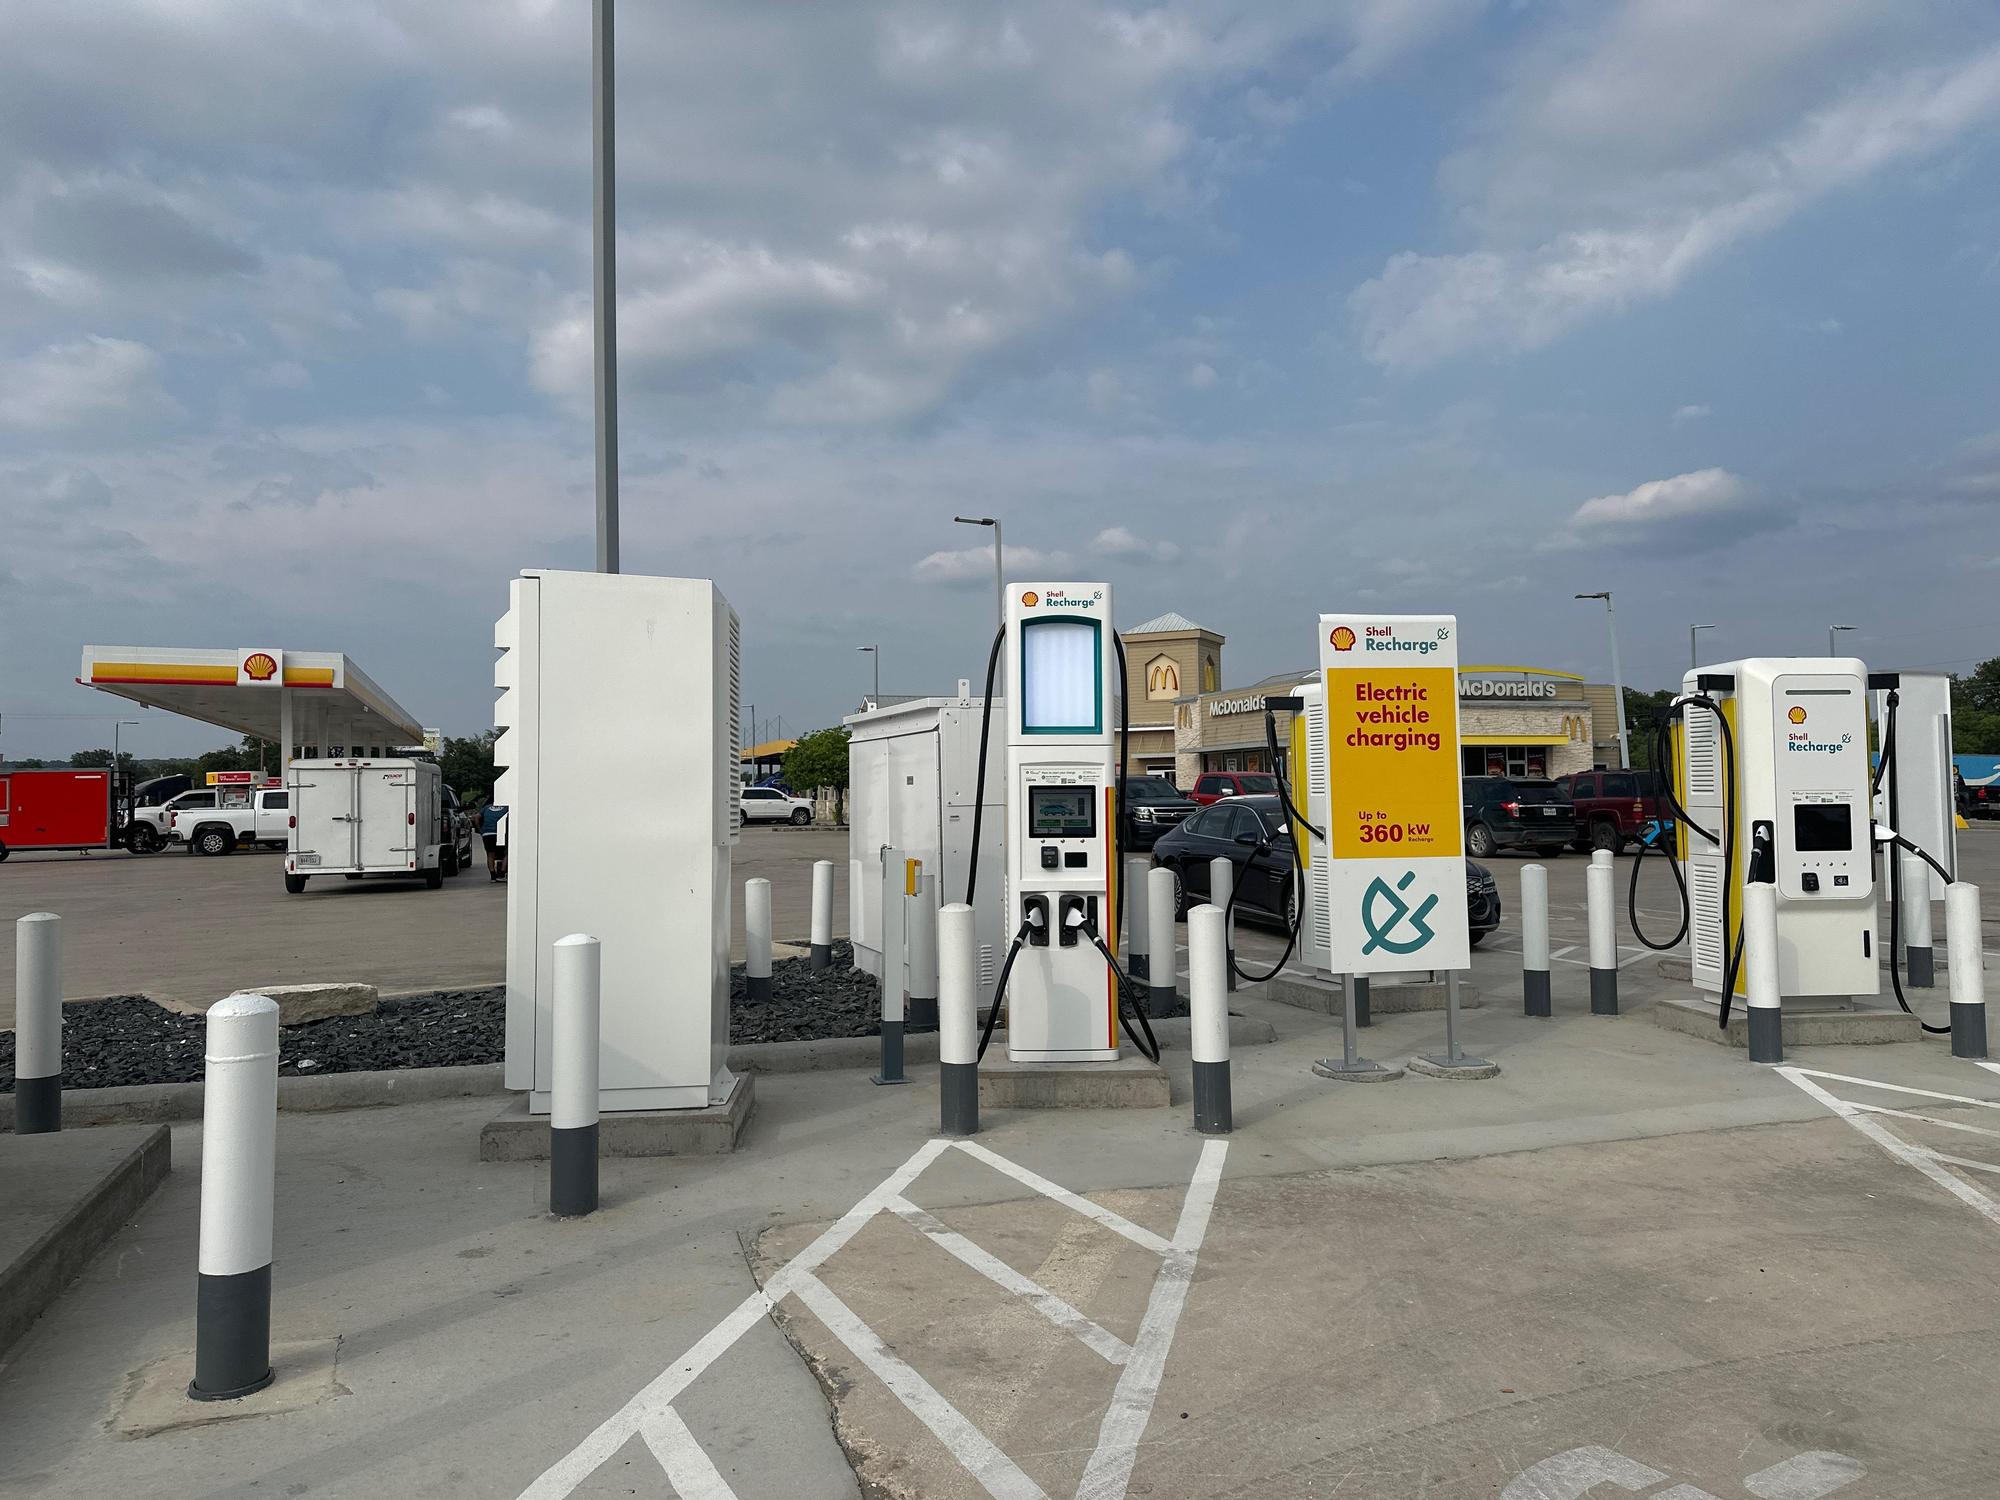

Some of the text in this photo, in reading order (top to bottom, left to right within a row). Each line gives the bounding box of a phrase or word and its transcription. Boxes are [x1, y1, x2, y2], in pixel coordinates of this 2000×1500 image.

[1046, 597, 1095, 609] Recharge
[1365, 626, 1392, 637] Shell
[1365, 636, 1438, 655] Recharge
[1356, 682, 1428, 701] Electric
[1209, 694, 1267, 717] McDonald's
[1356, 704, 1430, 724] vehicle
[1346, 727, 1441, 751] charging
[1788, 733, 1808, 741] Shell
[1788, 741, 1843, 754] Recharge
[1358, 811, 1387, 822] Up to
[1359, 823, 1431, 843] 360 kW
